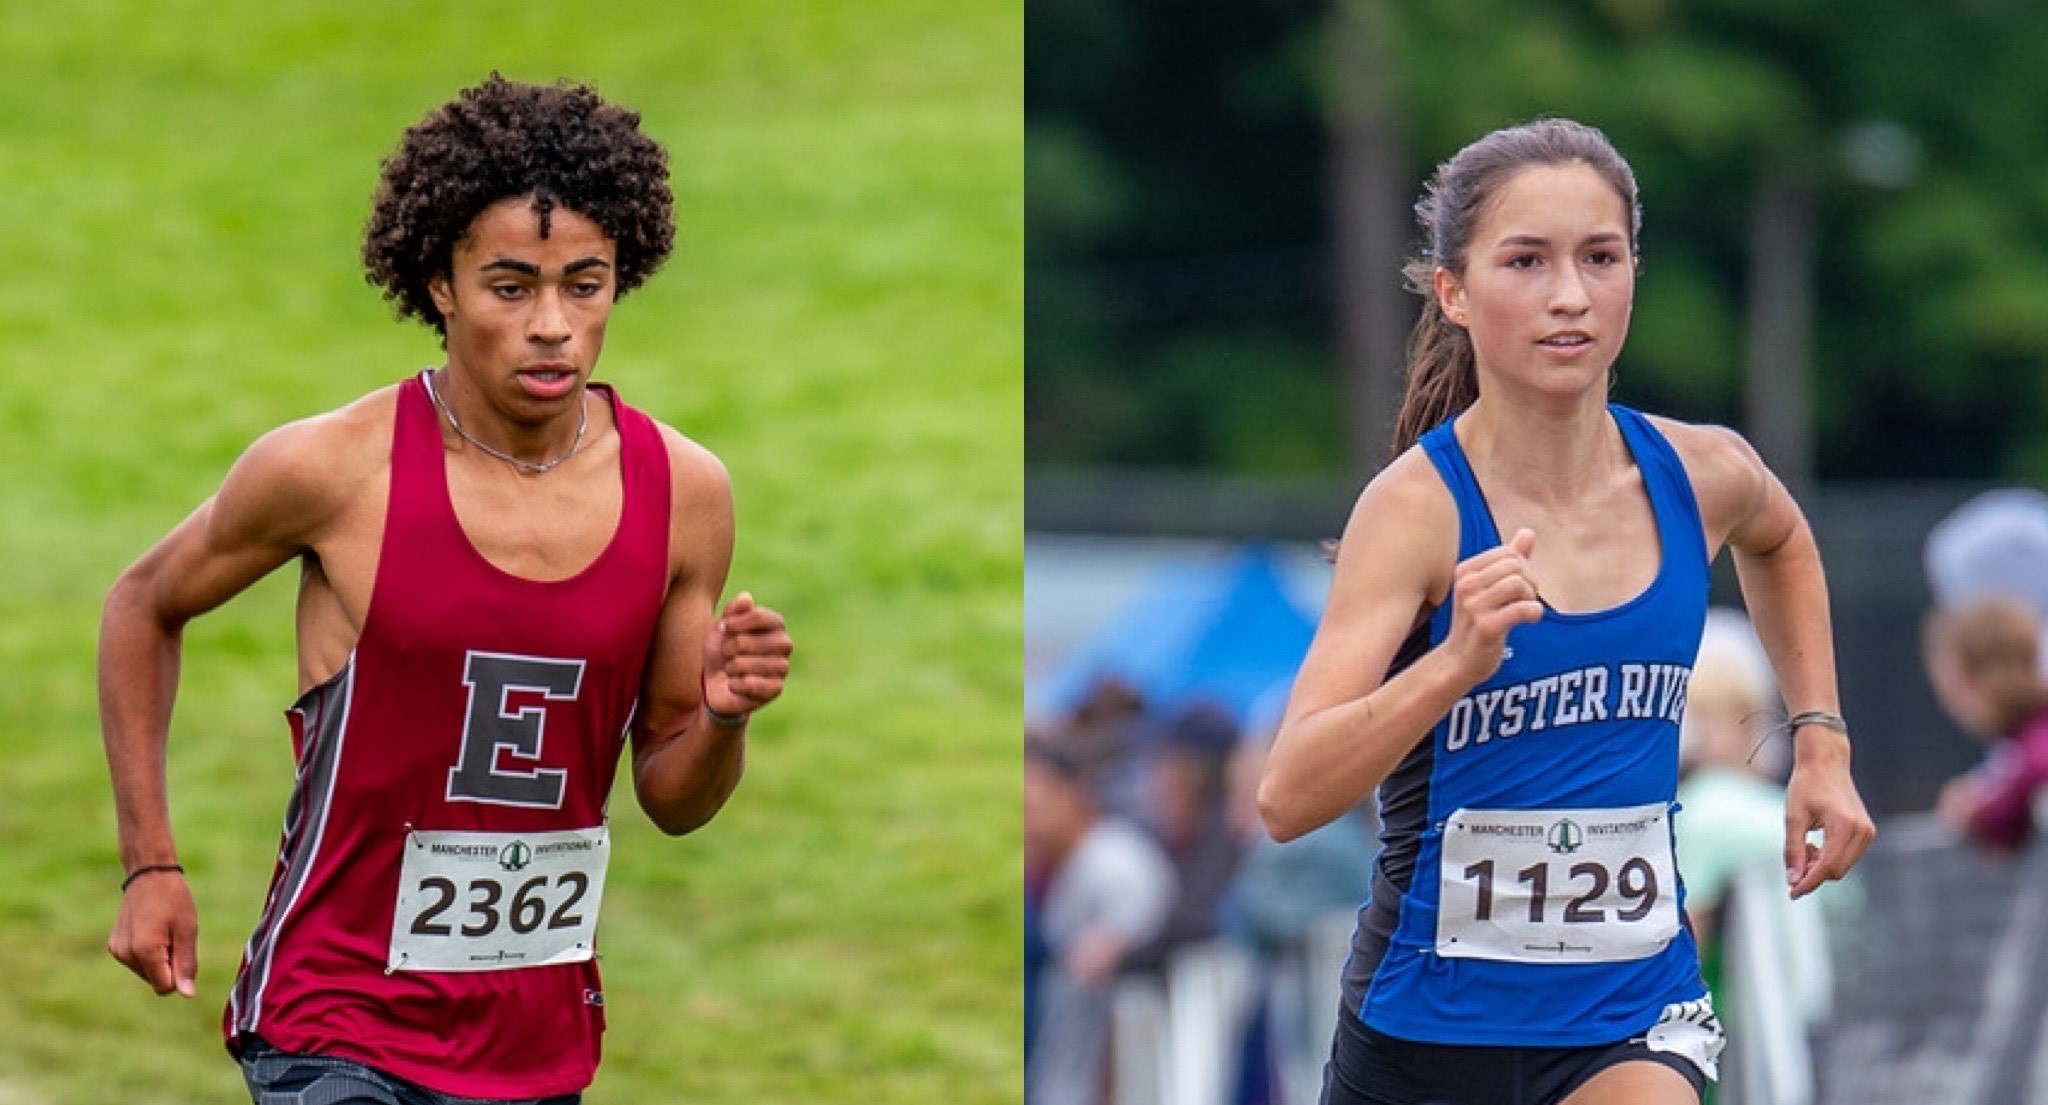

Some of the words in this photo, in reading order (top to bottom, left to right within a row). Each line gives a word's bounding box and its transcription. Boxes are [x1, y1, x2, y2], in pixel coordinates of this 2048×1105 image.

[446, 650, 587, 809] E
[1446, 666, 1608, 752] OYSTER
[431, 844, 498, 855] MANCHESTER
[1470, 824, 1544, 836] MANCHESTER
[411, 871, 589, 937] 2362
[1463, 857, 1658, 923] 1129
